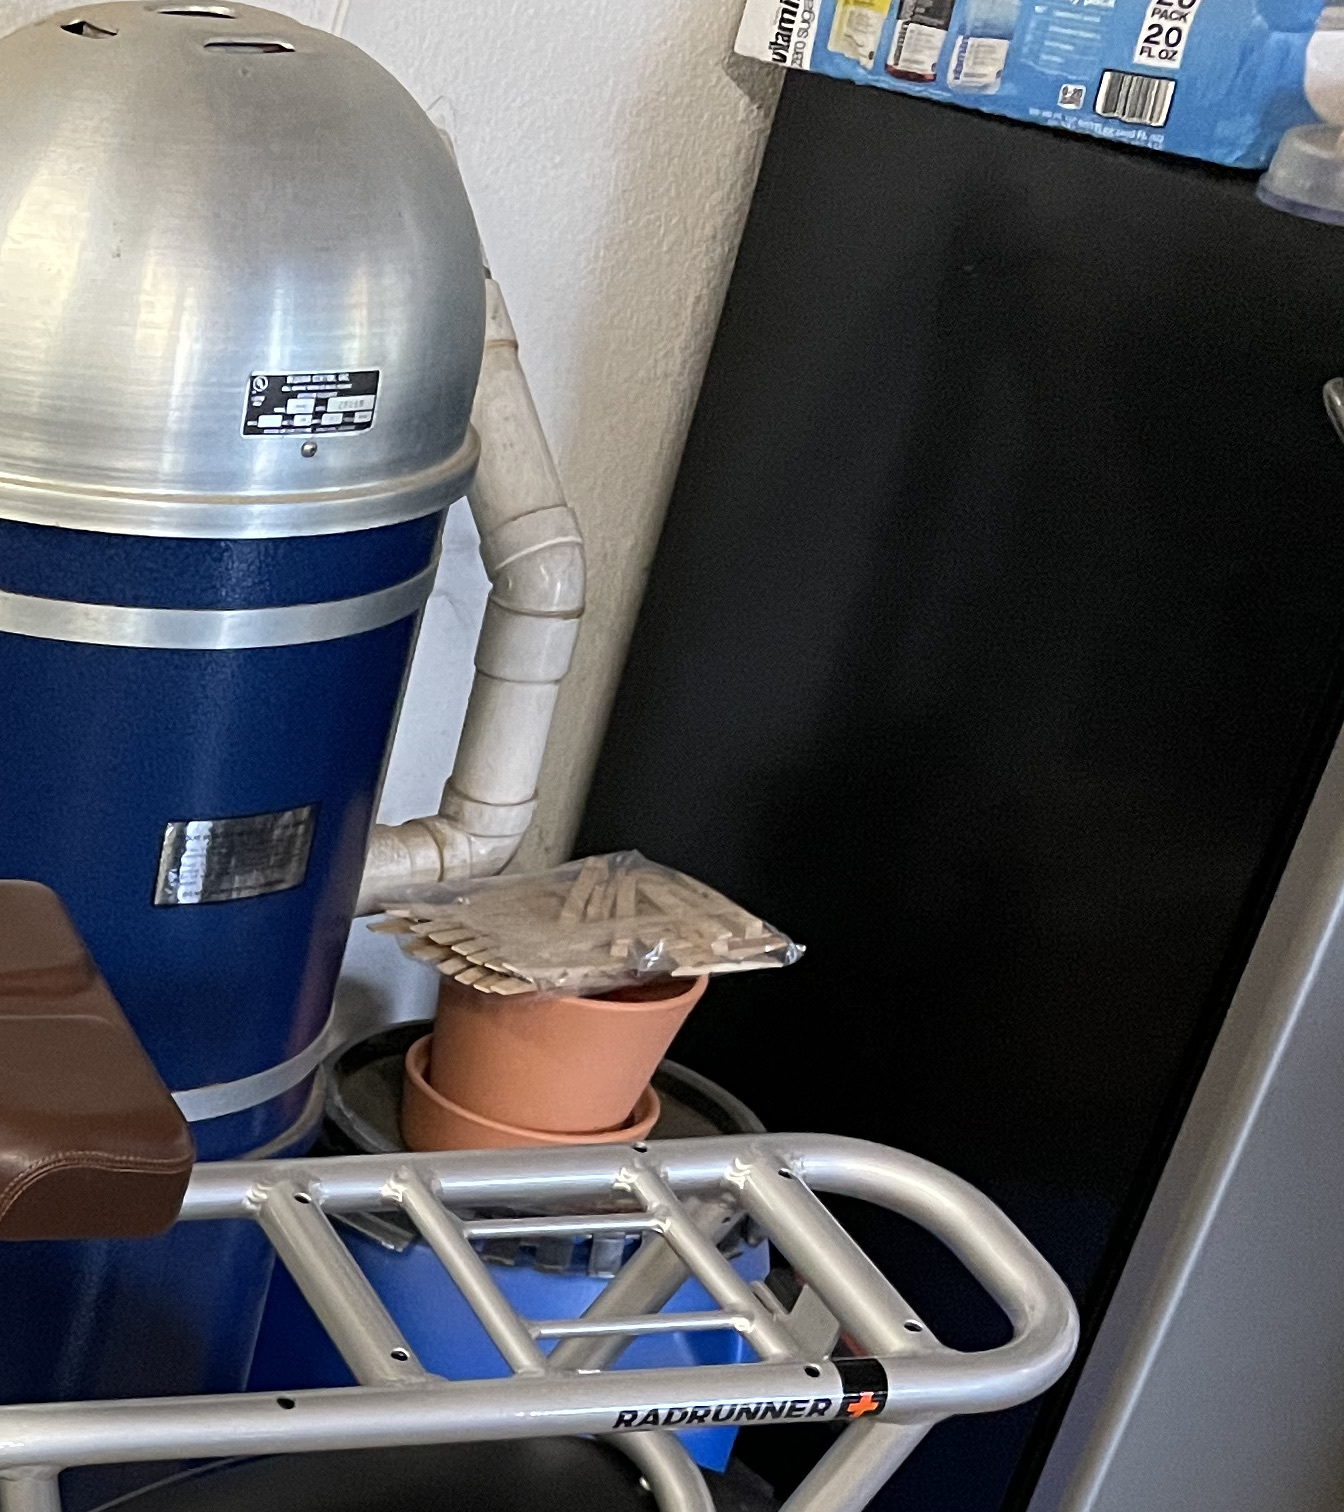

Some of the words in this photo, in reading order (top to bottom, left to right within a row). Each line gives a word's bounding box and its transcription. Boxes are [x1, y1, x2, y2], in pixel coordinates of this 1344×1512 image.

[1151, 8, 1191, 23] PACK
[1143, 24, 1182, 48] 20
[1139, 46, 1156, 58] FL
[1158, 50, 1178, 61] OZ
[612, 1398, 832, 1429] RADRUNNER
